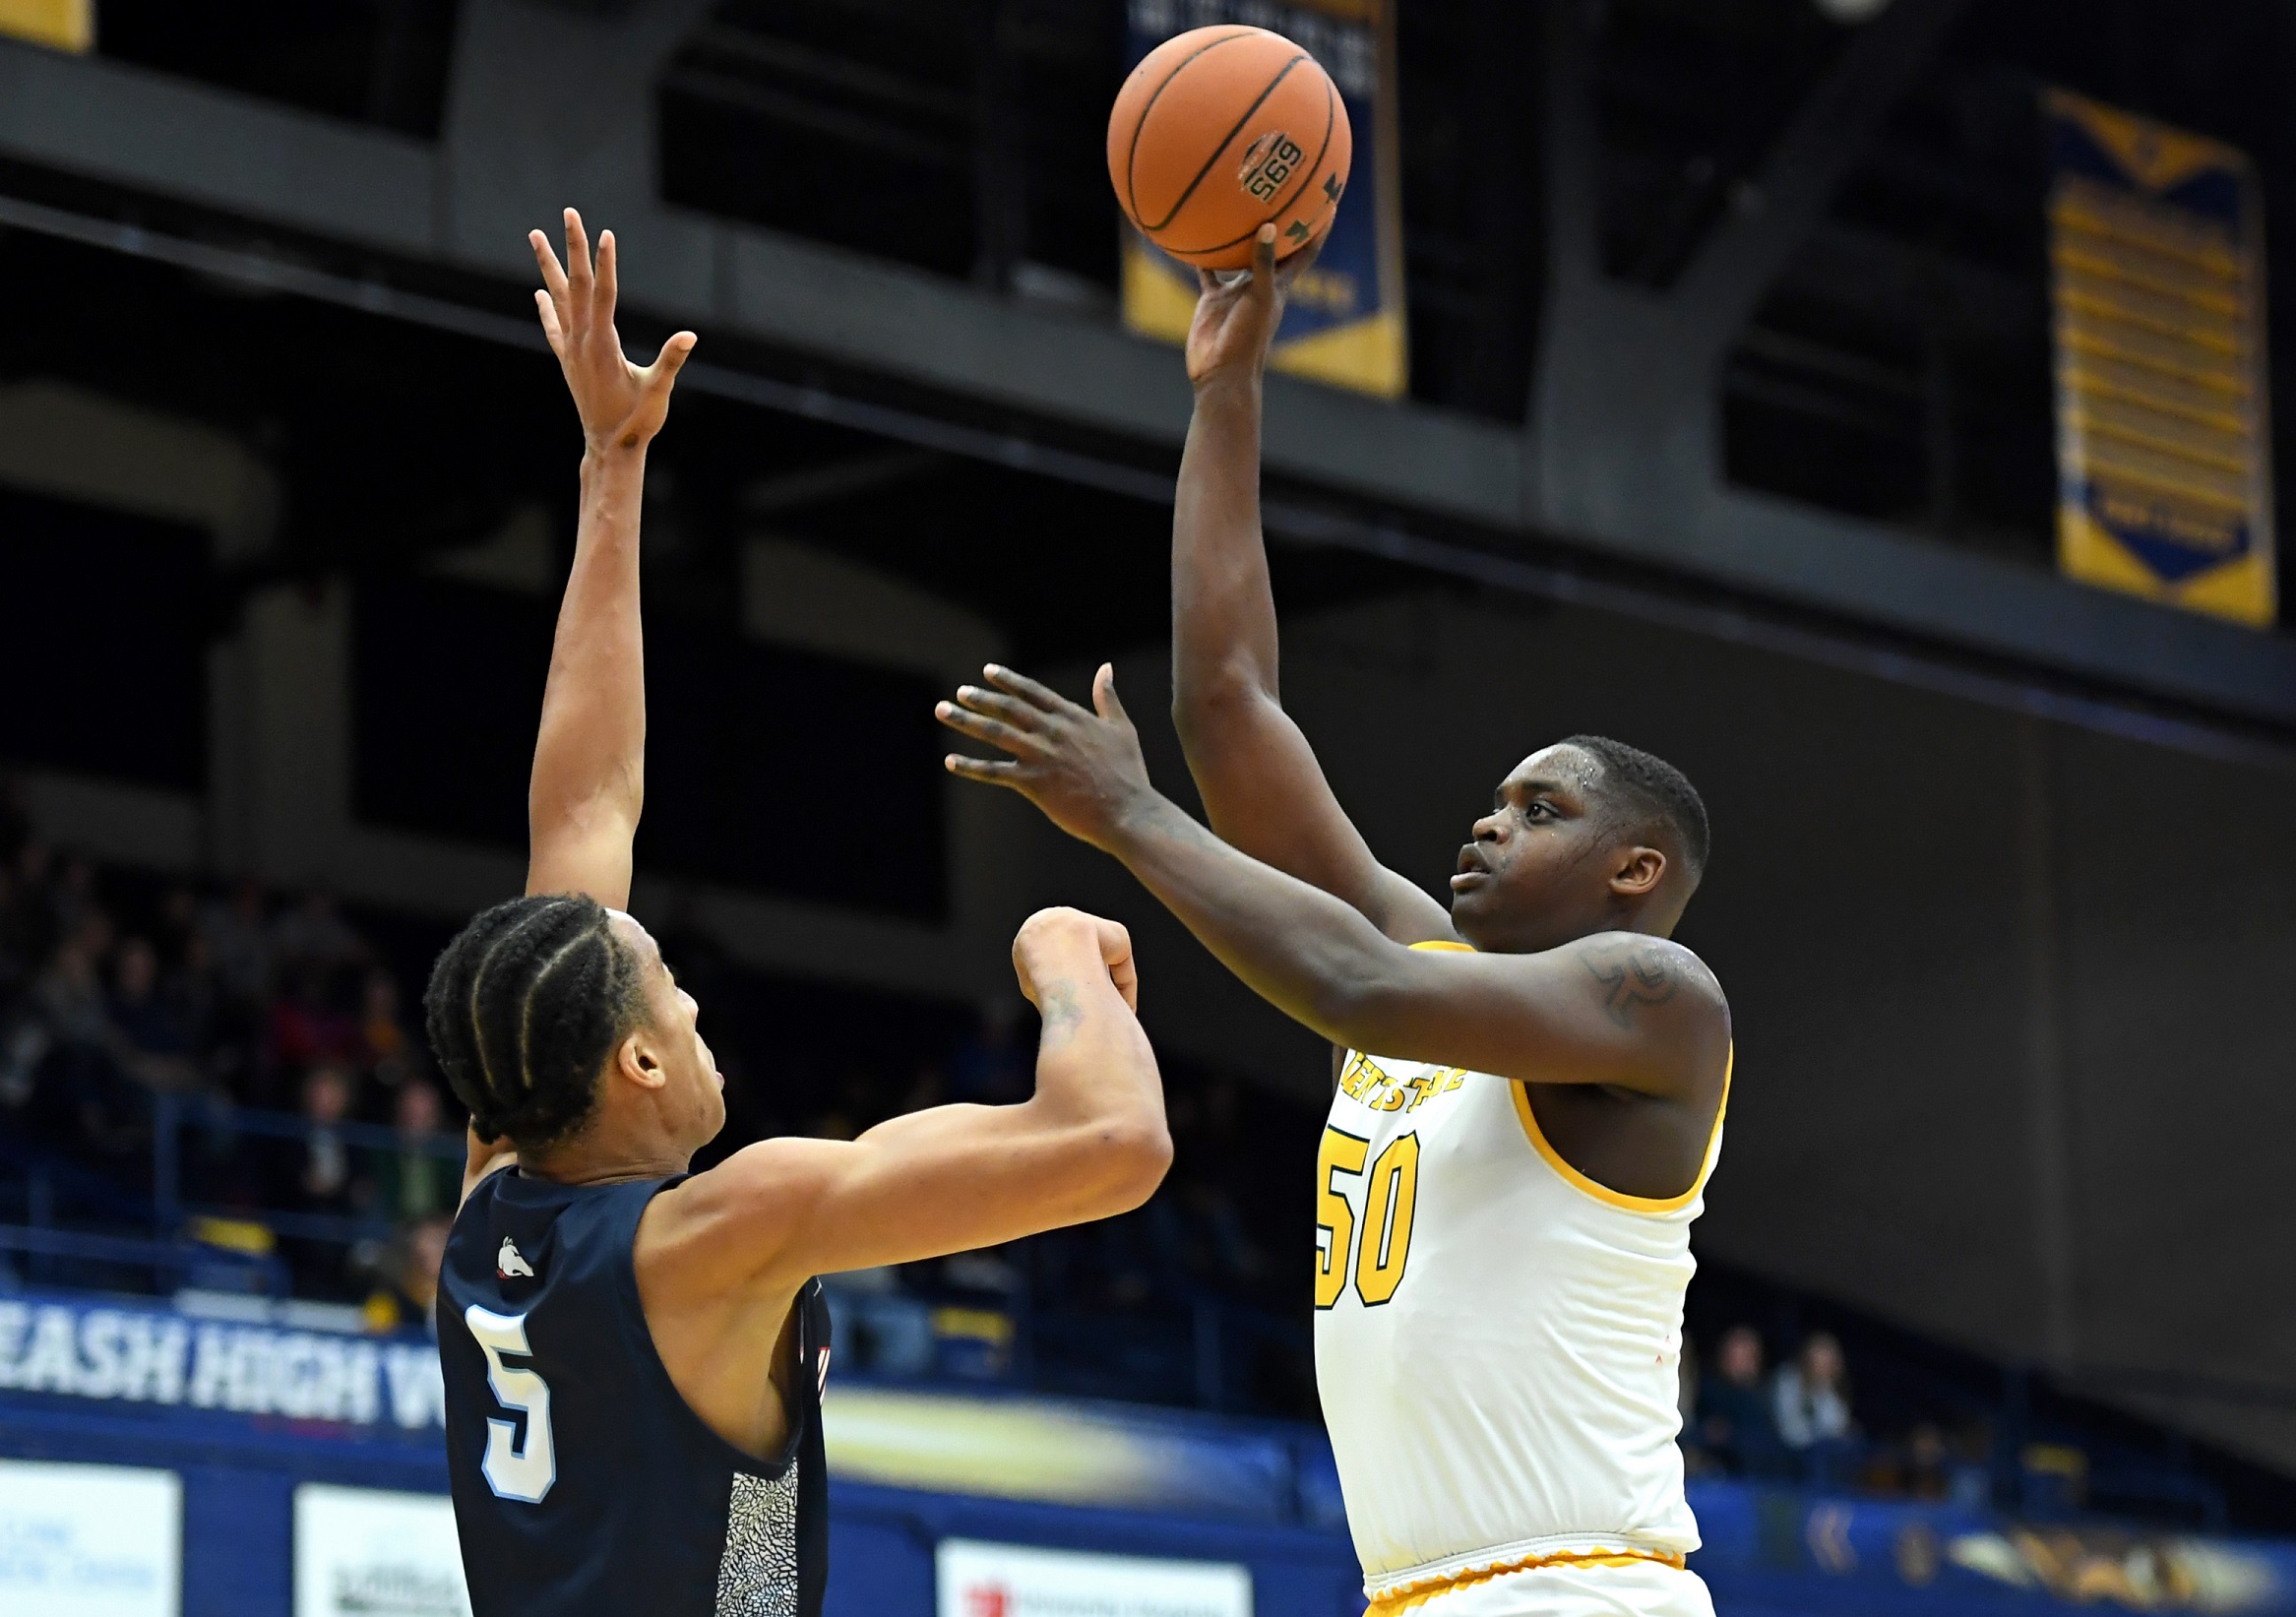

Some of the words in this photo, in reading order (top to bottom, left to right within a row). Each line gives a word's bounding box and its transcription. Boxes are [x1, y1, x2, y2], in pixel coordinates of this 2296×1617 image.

[1250, 140, 1302, 202] 695
[1315, 1123, 1420, 1310] 50
[191, 1323, 381, 1425] HIGH
[465, 1304, 556, 1504] 5
